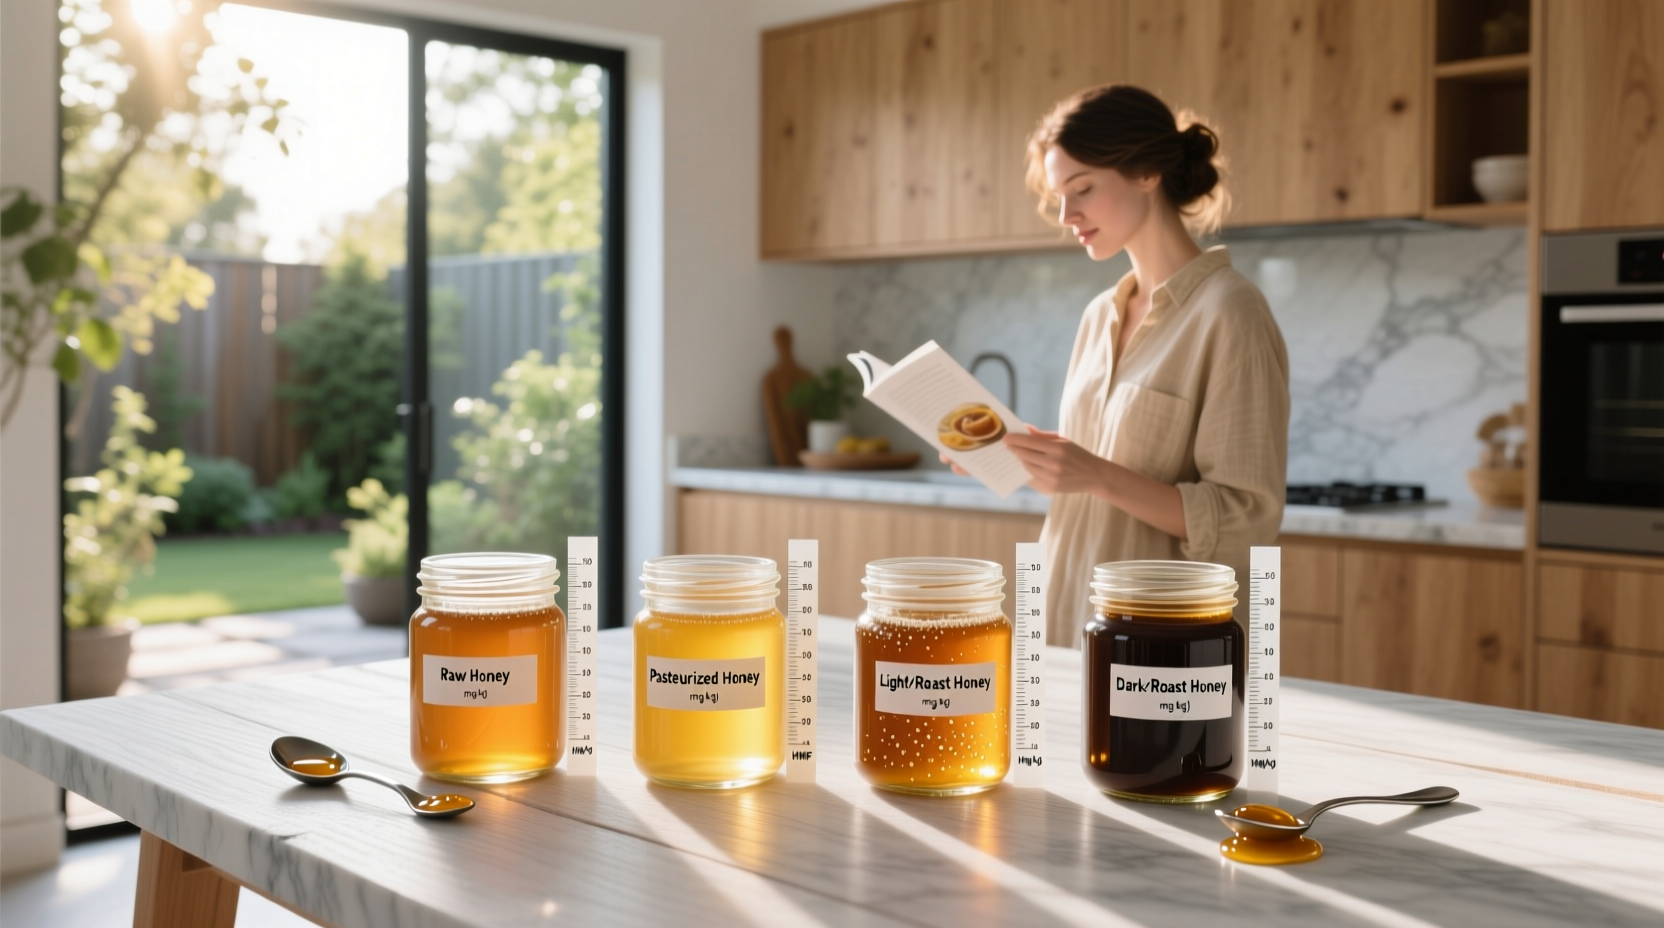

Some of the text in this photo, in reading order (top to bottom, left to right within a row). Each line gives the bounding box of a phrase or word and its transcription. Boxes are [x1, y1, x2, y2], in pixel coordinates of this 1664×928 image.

[441, 667, 510, 686] Raw Honey
[650, 668, 760, 686] Pasteurized Honey
[880, 674, 991, 692] Light/Roast Honey
[1116, 676, 1227, 695] Dark/Roast Honey
[464, 690, 477, 699] mg
[690, 693, 704, 704] mg
[922, 699, 938, 710] mg
[1159, 702, 1174, 713] mg
